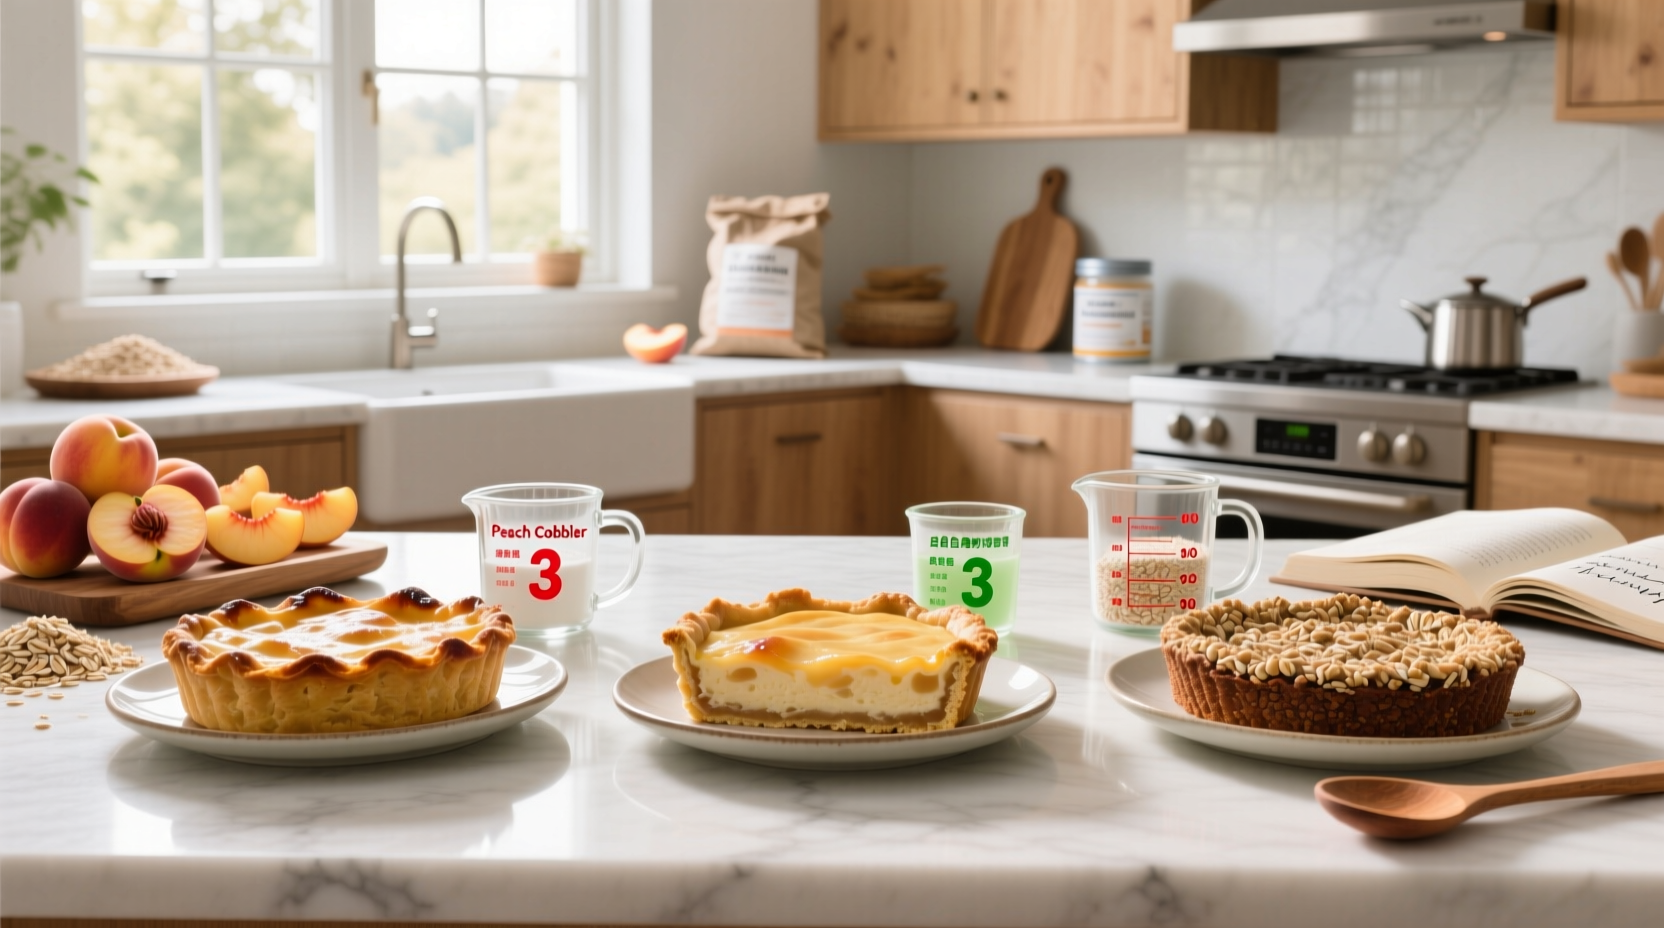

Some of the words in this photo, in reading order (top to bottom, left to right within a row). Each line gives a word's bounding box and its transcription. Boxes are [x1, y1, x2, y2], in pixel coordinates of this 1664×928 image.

[491, 524, 531, 539] Peach
[534, 524, 588, 539] Cobbler
[528, 548, 563, 601] 3
[961, 556, 994, 608] 3
